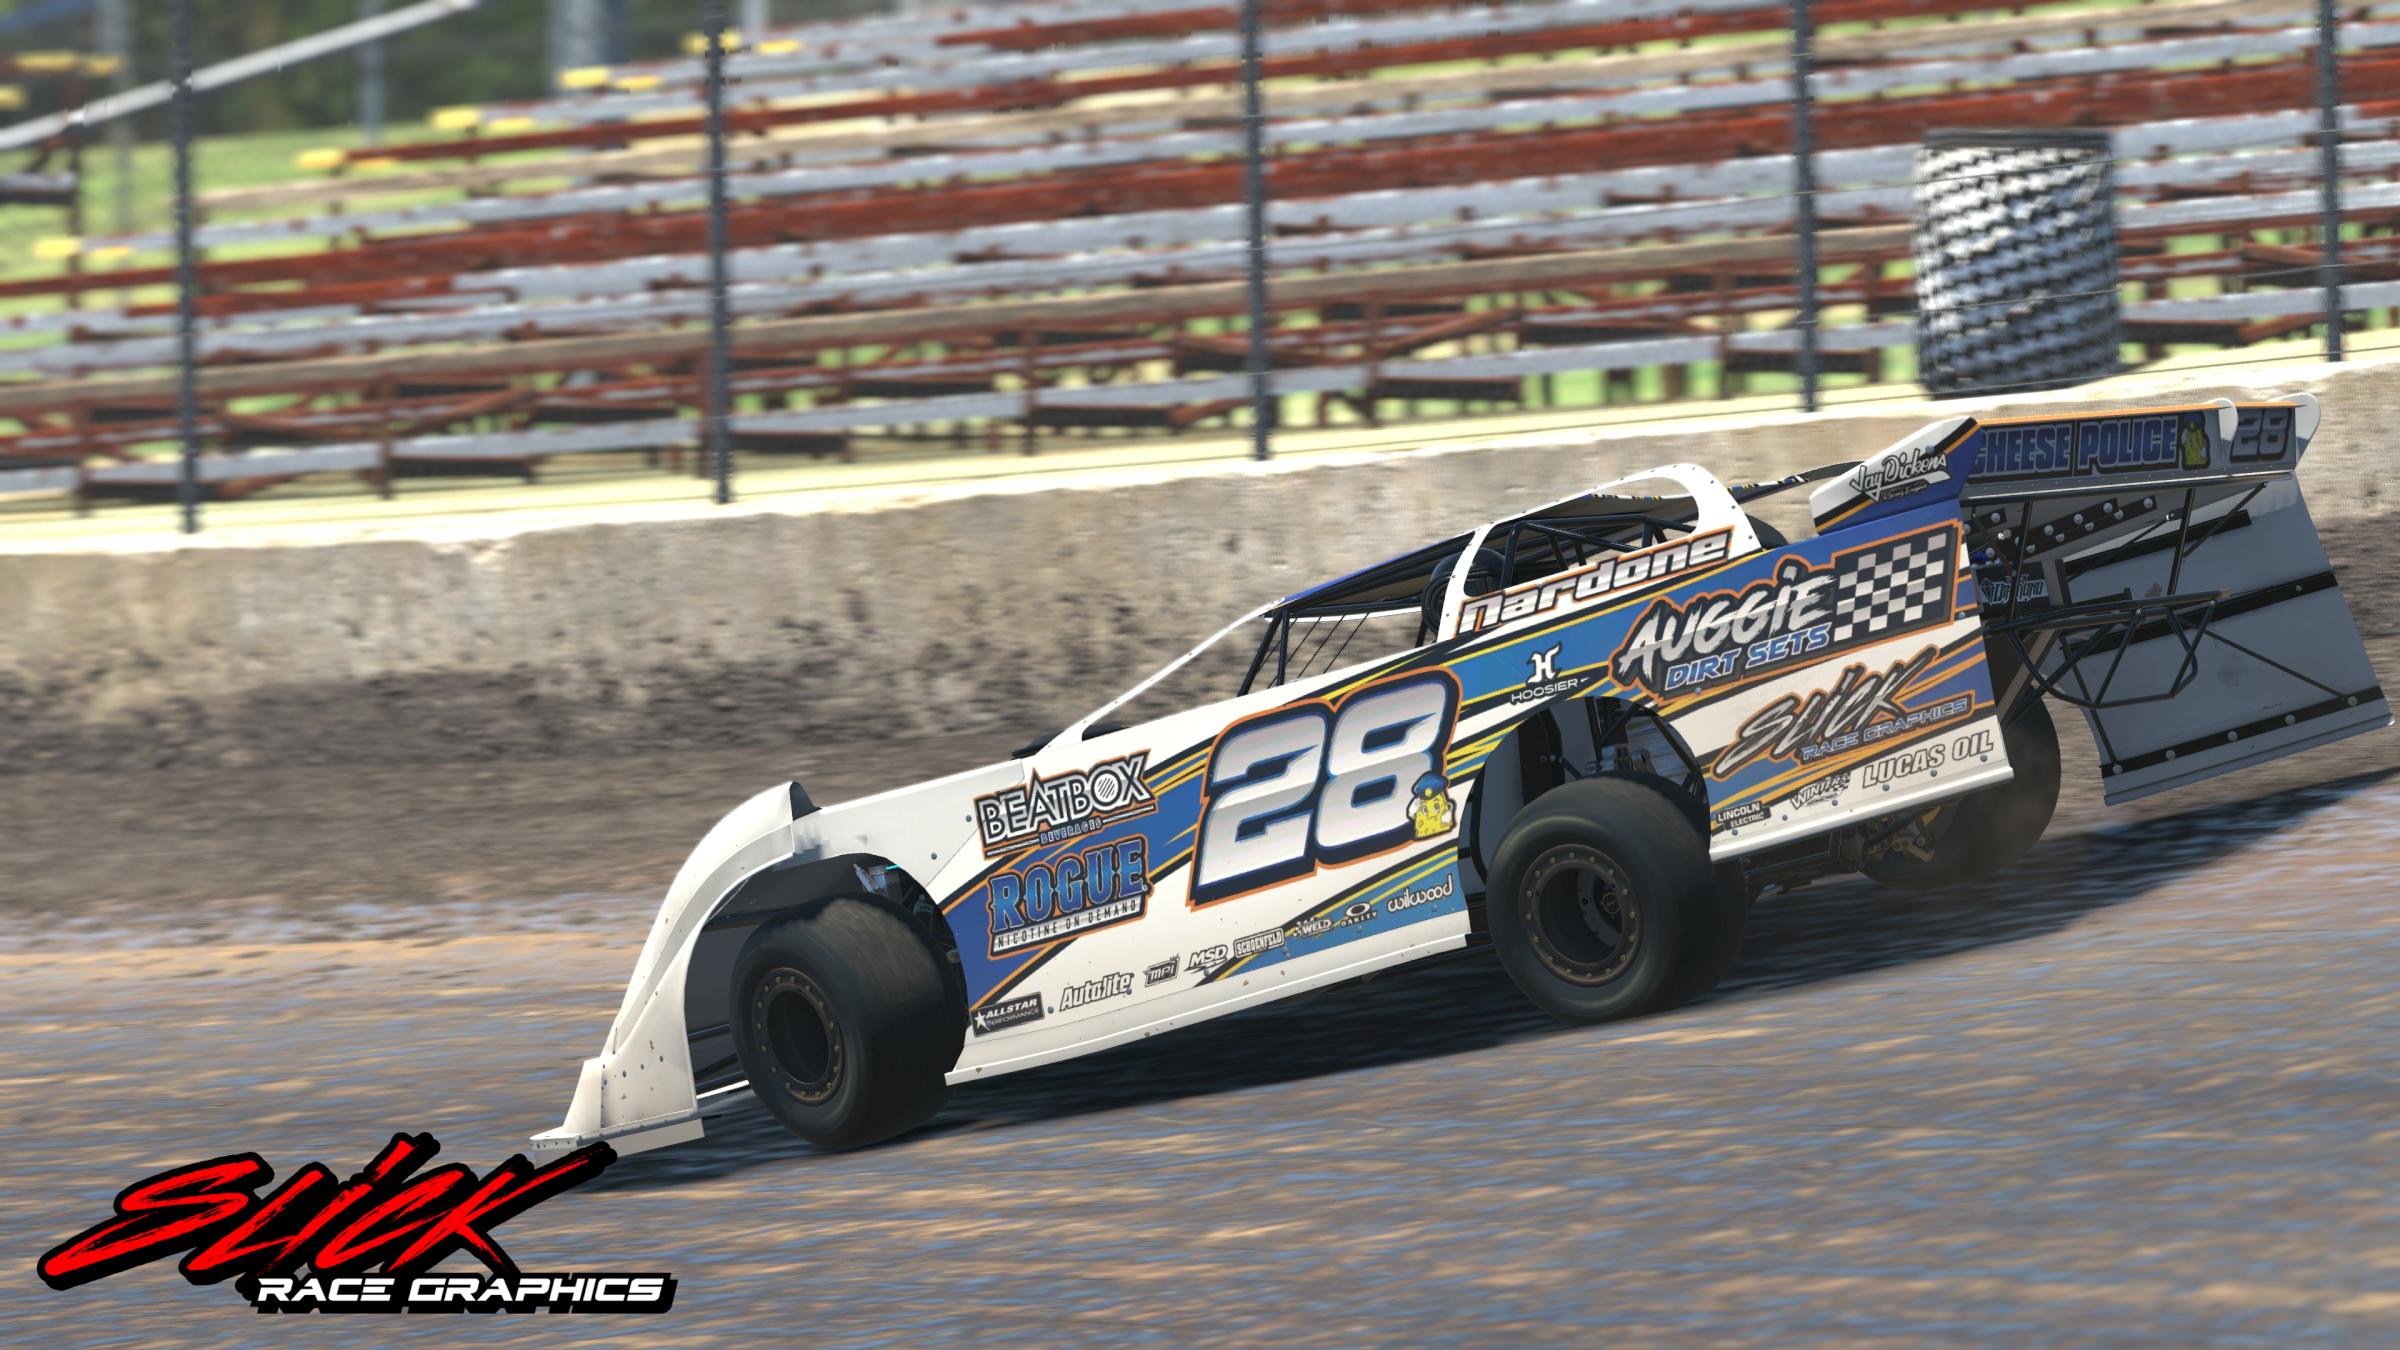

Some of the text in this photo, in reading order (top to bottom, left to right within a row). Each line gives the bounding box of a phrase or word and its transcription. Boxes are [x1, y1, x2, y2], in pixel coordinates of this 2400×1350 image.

[1970, 415, 2179, 476] CHEESE POLICE
[2231, 408, 2290, 459] 28
[1849, 448, 1948, 503] Jay Dickens
[1457, 531, 1729, 636] nardone
[1664, 622, 1832, 691] DIRT SETS
[1511, 678, 1578, 703] HOOSIER
[1802, 697, 1969, 761] RACE GRAPHICS
[1862, 730, 1994, 789] LUCAS OIL
[977, 753, 1152, 845] BEATBOX
[1195, 678, 1448, 889] 28
[1790, 772, 1851, 810] WINTERS
[1040, 817, 1102, 845] BEVERAGES
[1717, 802, 1761, 822] LINCOLN
[1730, 811, 1765, 828] ELECTRIC
[989, 838, 1144, 933] ROGUE
[1387, 873, 1454, 913] wilwood
[997, 899, 1138, 947] NICOTINE ON DEMAND
[1302, 919, 1332, 935] WELD
[1341, 911, 1378, 927] OAKLEY
[1189, 945, 1229, 969] MSD
[1236, 931, 1283, 956] SCHOENFELD
[985, 998, 1038, 1020] ALLSTAR
[1059, 972, 1134, 1012] Autolite
[987, 1008, 1040, 1027] ERFORMANCE
